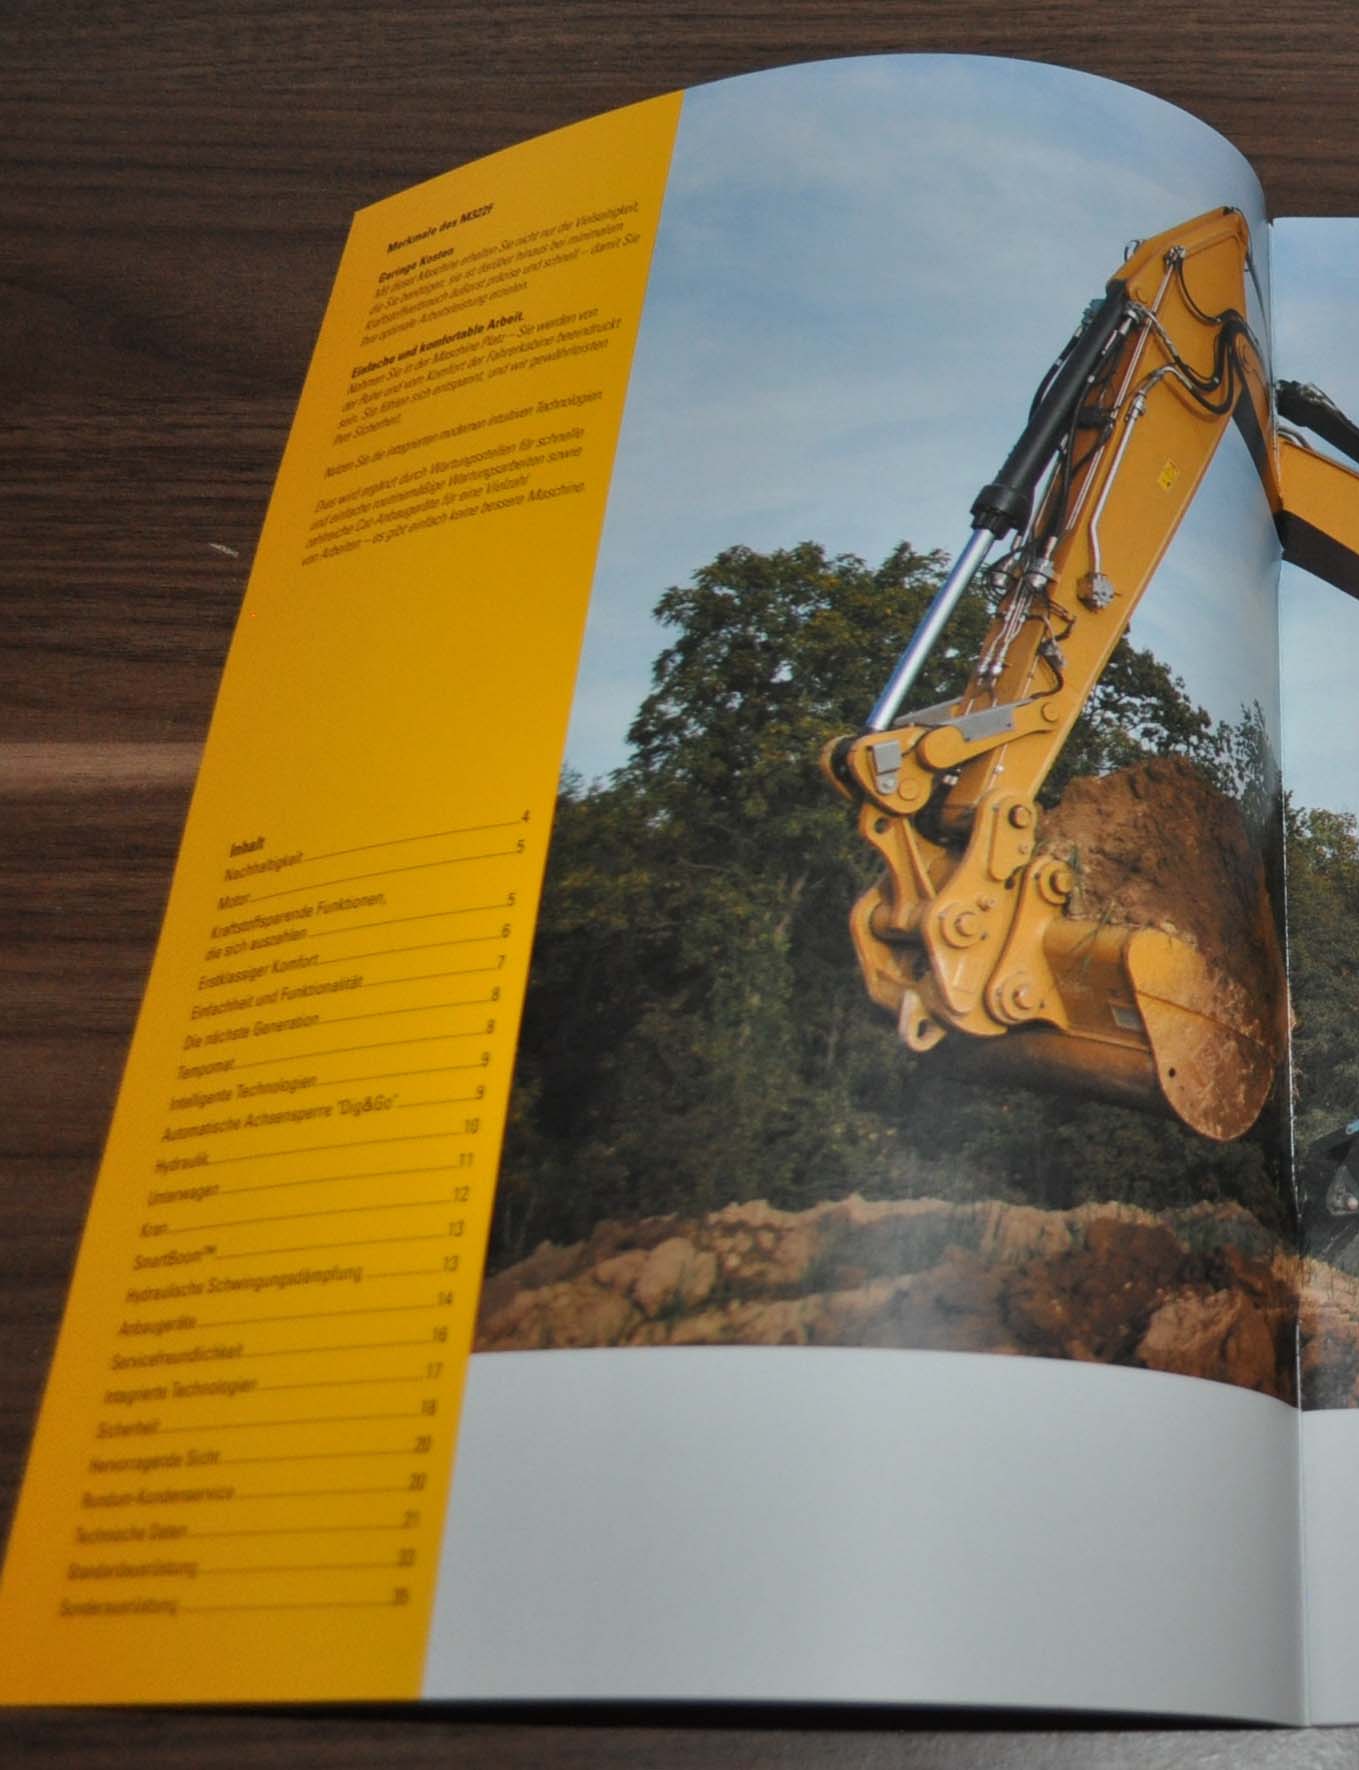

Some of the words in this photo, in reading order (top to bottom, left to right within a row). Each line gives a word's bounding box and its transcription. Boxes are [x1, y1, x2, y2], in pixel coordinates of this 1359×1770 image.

[419, 247, 453, 266] Kosten
[397, 345, 417, 361] und
[420, 325, 483, 352] komfortable
[487, 312, 524, 330] Arbeit.
[521, 810, 530, 823] 4
[230, 836, 264, 857] Inhalt
[217, 893, 249, 910] Motor
[517, 839, 526, 853] 5
[507, 892, 516, 906] 5
[271, 954, 319, 974] Komfort
[502, 923, 511, 938] 6
[498, 955, 506, 969] 7
[476, 1084, 485, 1099] 9
[459, 1152, 474, 1168] 11
[453, 1186, 469, 1202] 12
[448, 1220, 465, 1237] 13
[444, 1255, 460, 1272] 13
